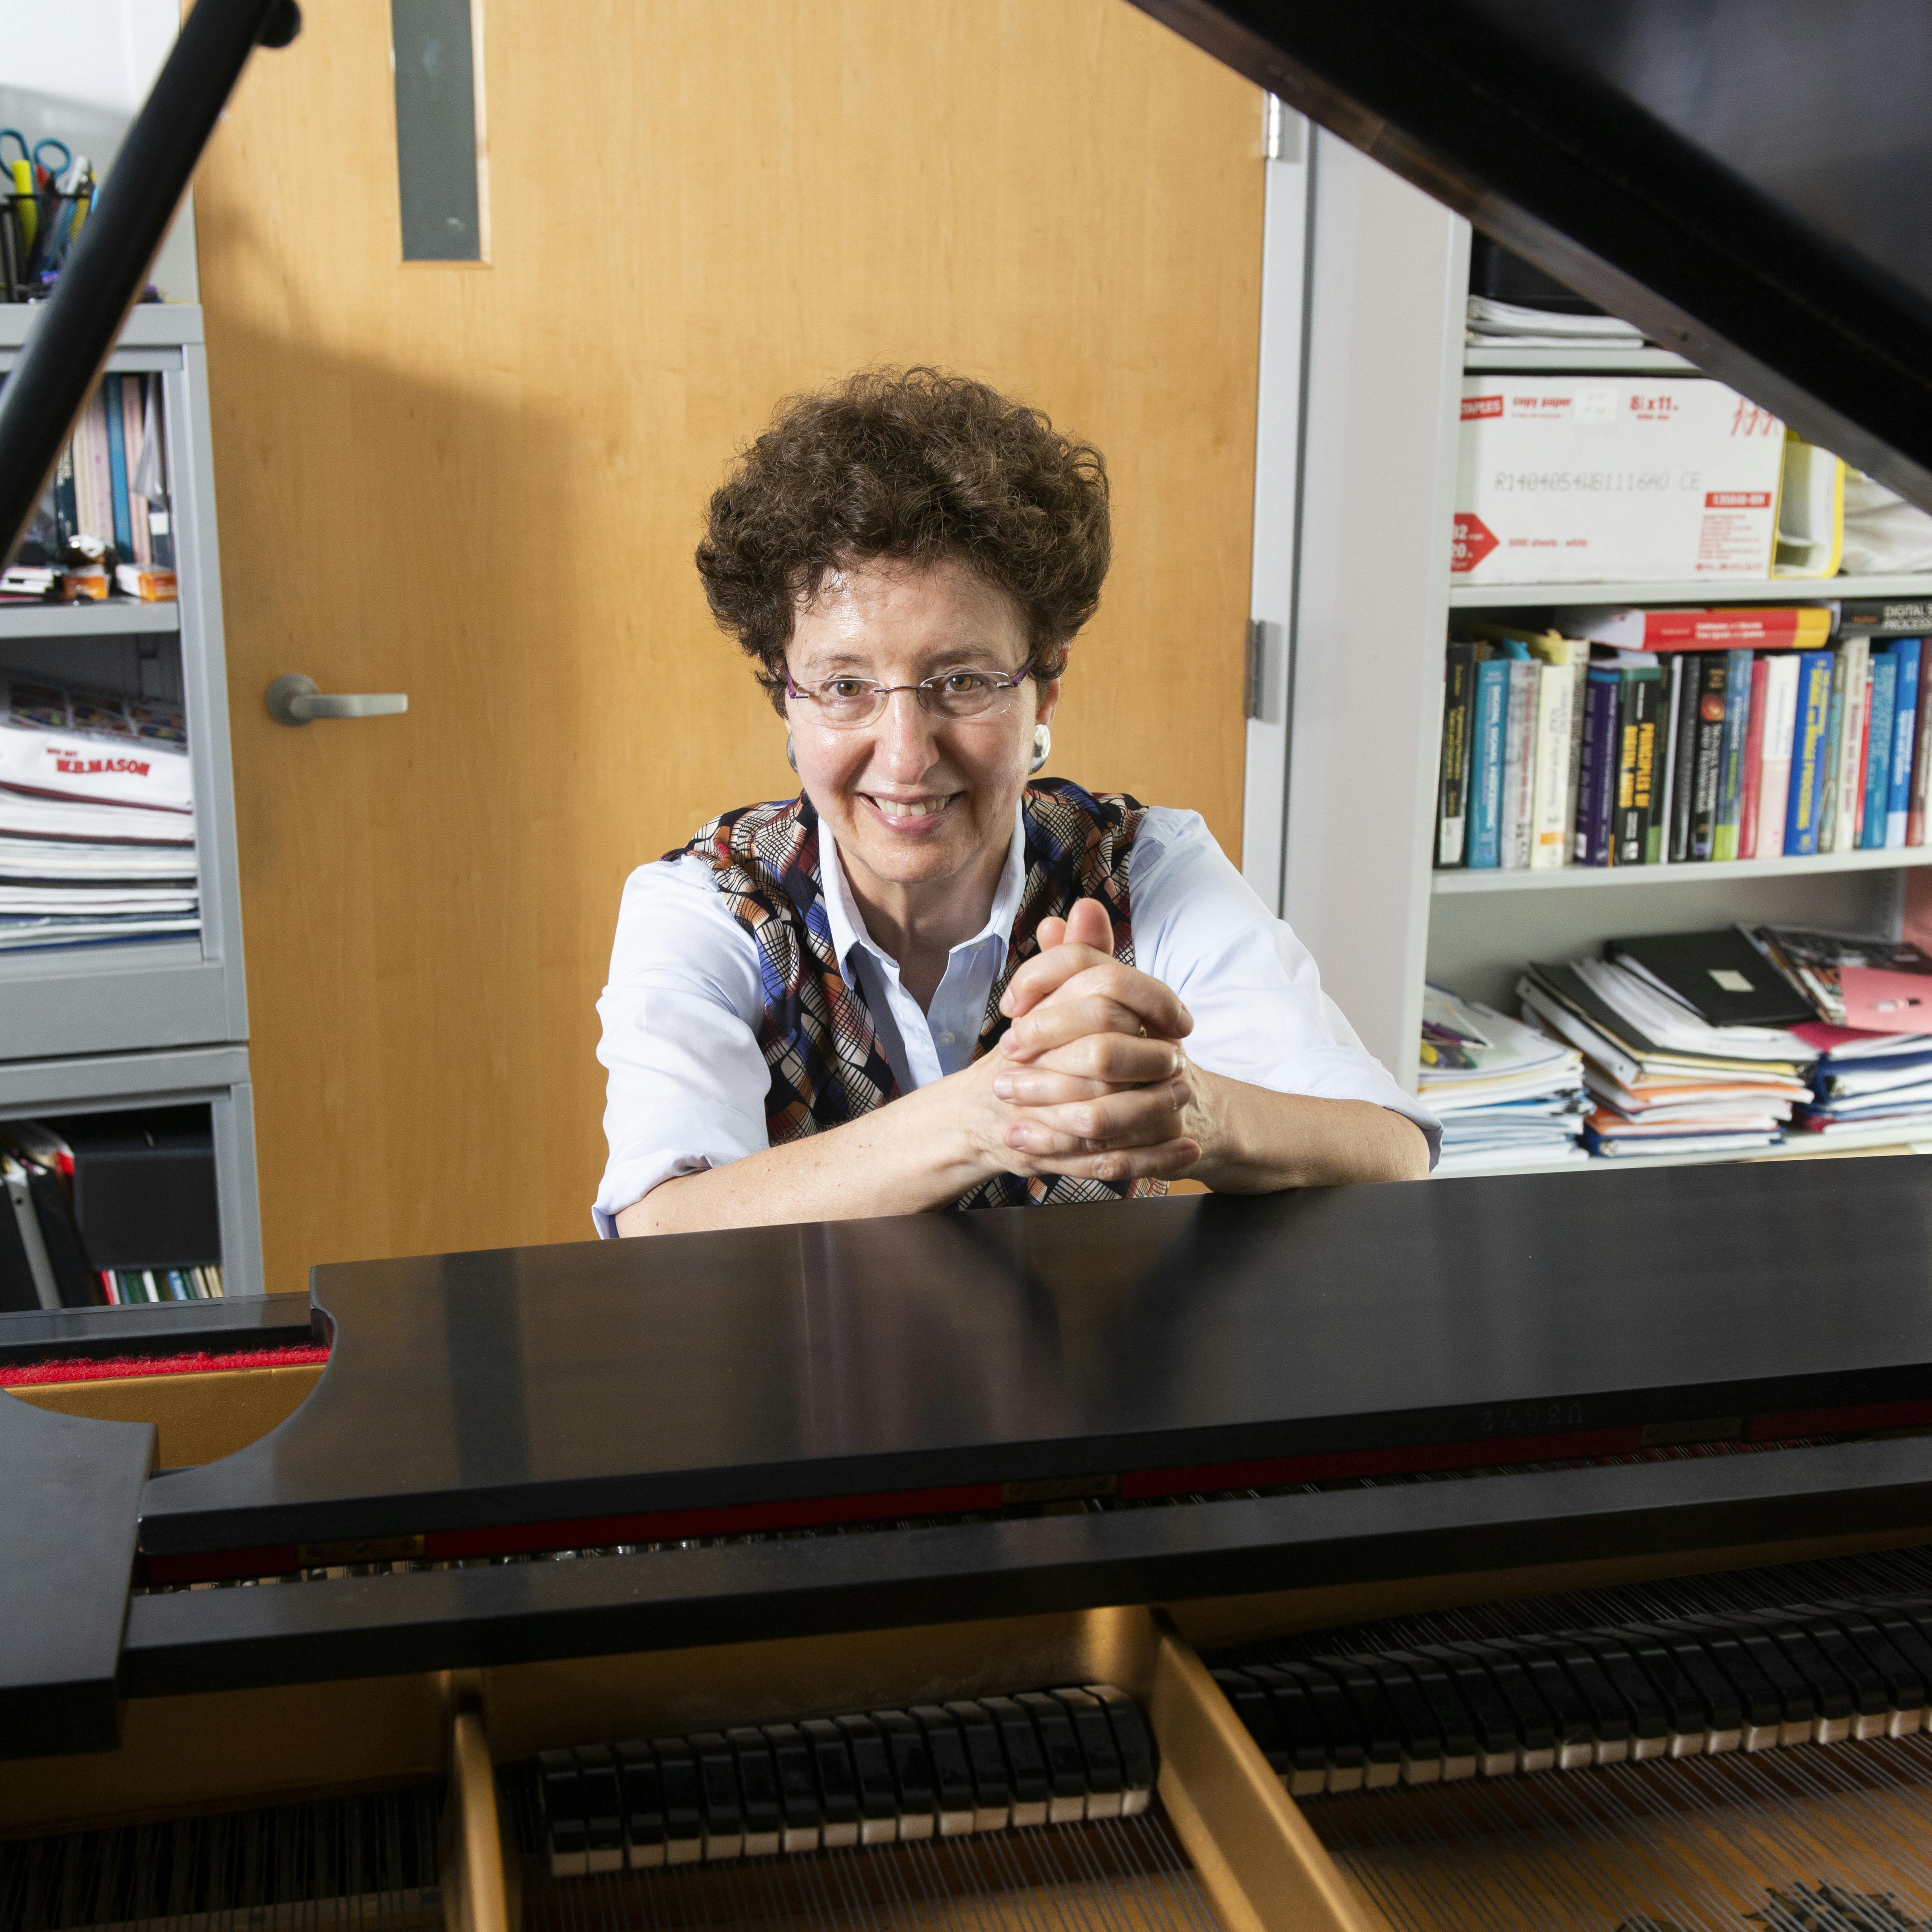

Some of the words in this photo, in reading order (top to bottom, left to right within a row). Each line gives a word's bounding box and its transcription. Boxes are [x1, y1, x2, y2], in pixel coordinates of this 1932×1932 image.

[1513, 398, 1537, 408] copy
[1541, 397, 1570, 408] paper
[1883, 605, 1924, 618] DIGITAL
[1490, 685, 1501, 723] DIGITAL
[1489, 726, 1499, 762] SIGNAL
[1622, 725, 1638, 768] DIGITAL
[1635, 723, 1655, 791] PRINCIPLES
[1486, 765, 1498, 829] PROCESSING
[1619, 773, 1634, 808] AUDIO
[1635, 793, 1650, 807] OF
[1797, 762, 1815, 830] PROCESSING
